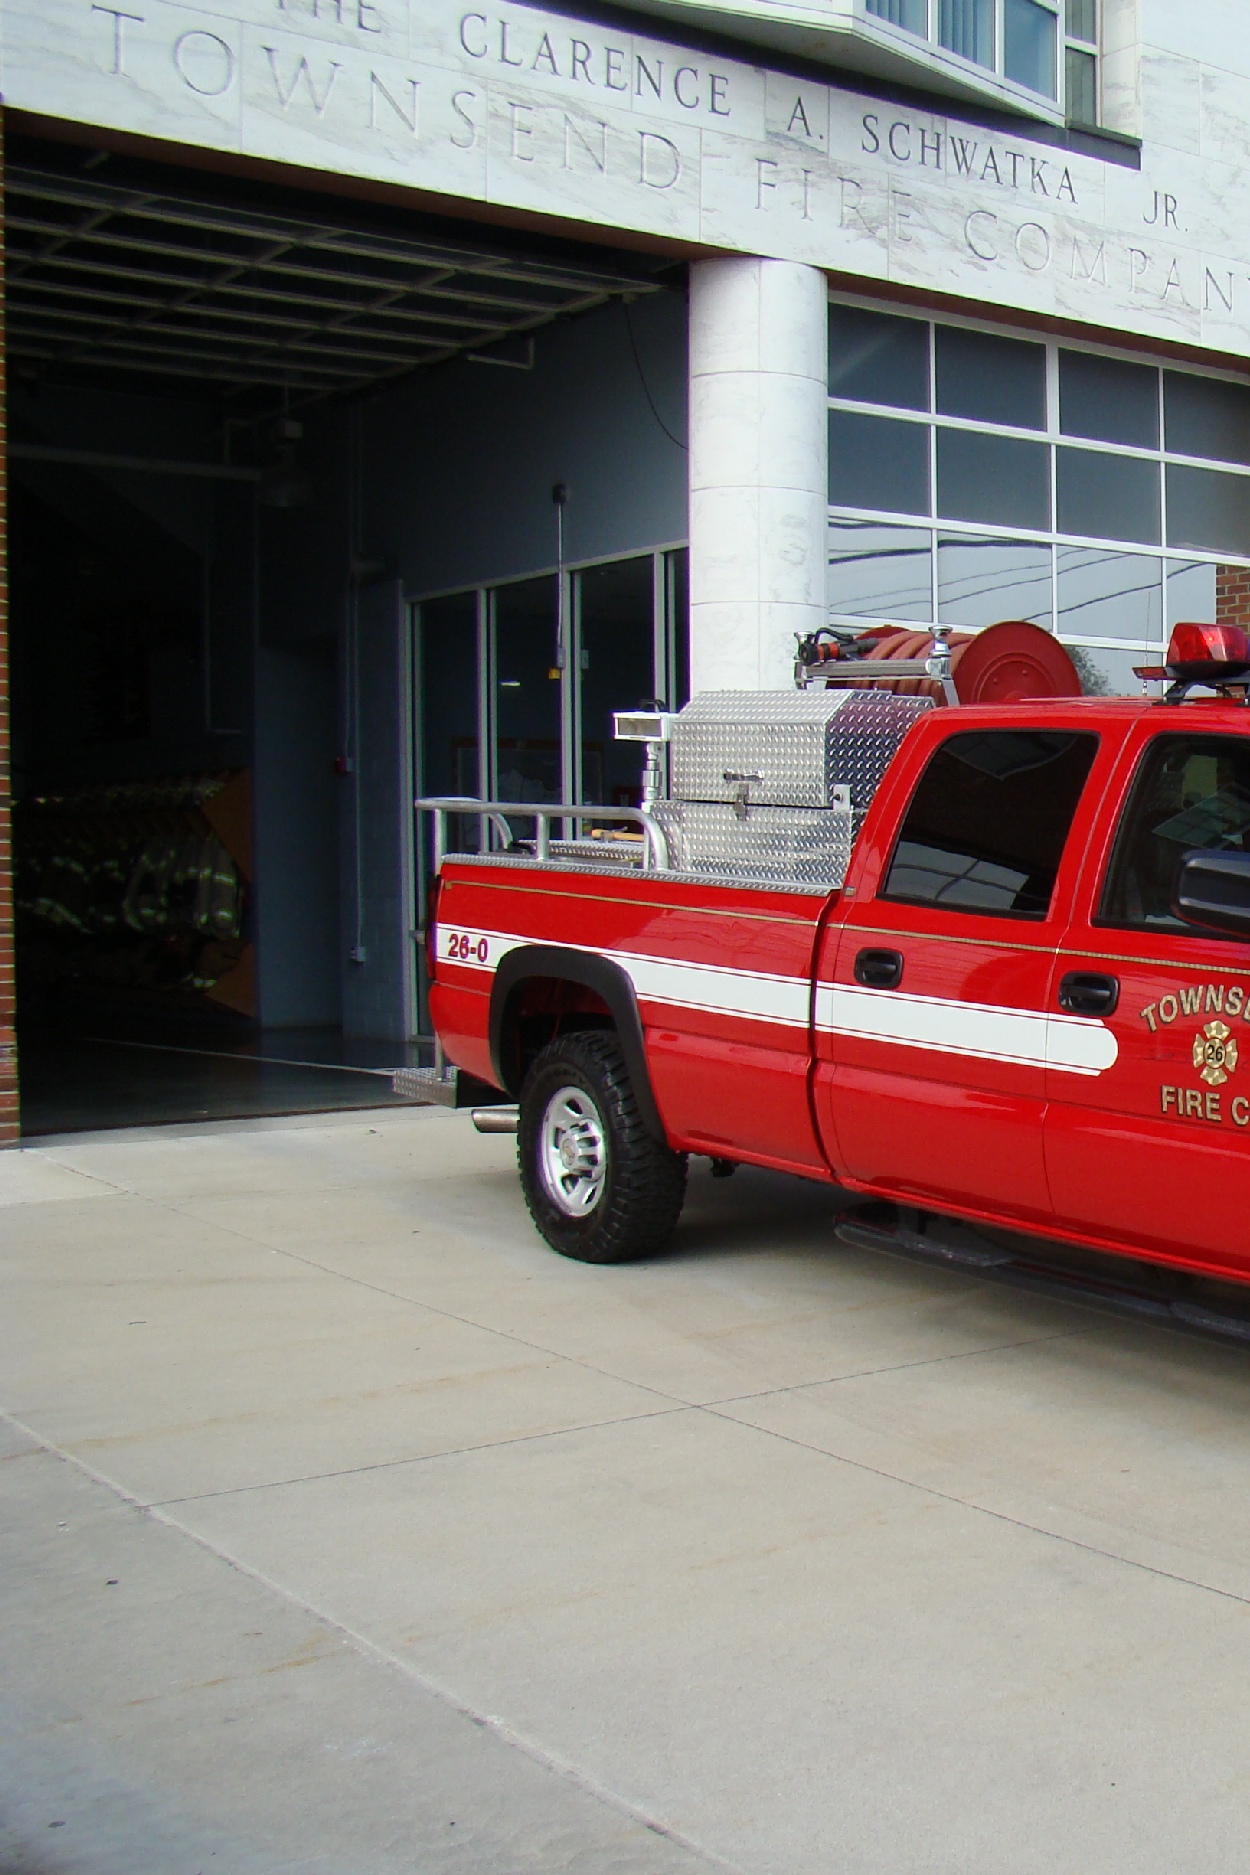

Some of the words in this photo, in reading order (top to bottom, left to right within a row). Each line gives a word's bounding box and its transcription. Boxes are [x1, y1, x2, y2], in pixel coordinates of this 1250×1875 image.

[92, 4, 682, 190] TOWNSEND
[755, 158, 913, 242] FIRE
[459, 13, 732, 117] CLARENCE
[786, 96, 825, 140] A.
[861, 114, 1077, 204] SCHWATKA
[1143, 190, 1189, 232] JR.
[1160, 1085, 1222, 1122] FIRE
[1207, 1045, 1223, 1061] 26
